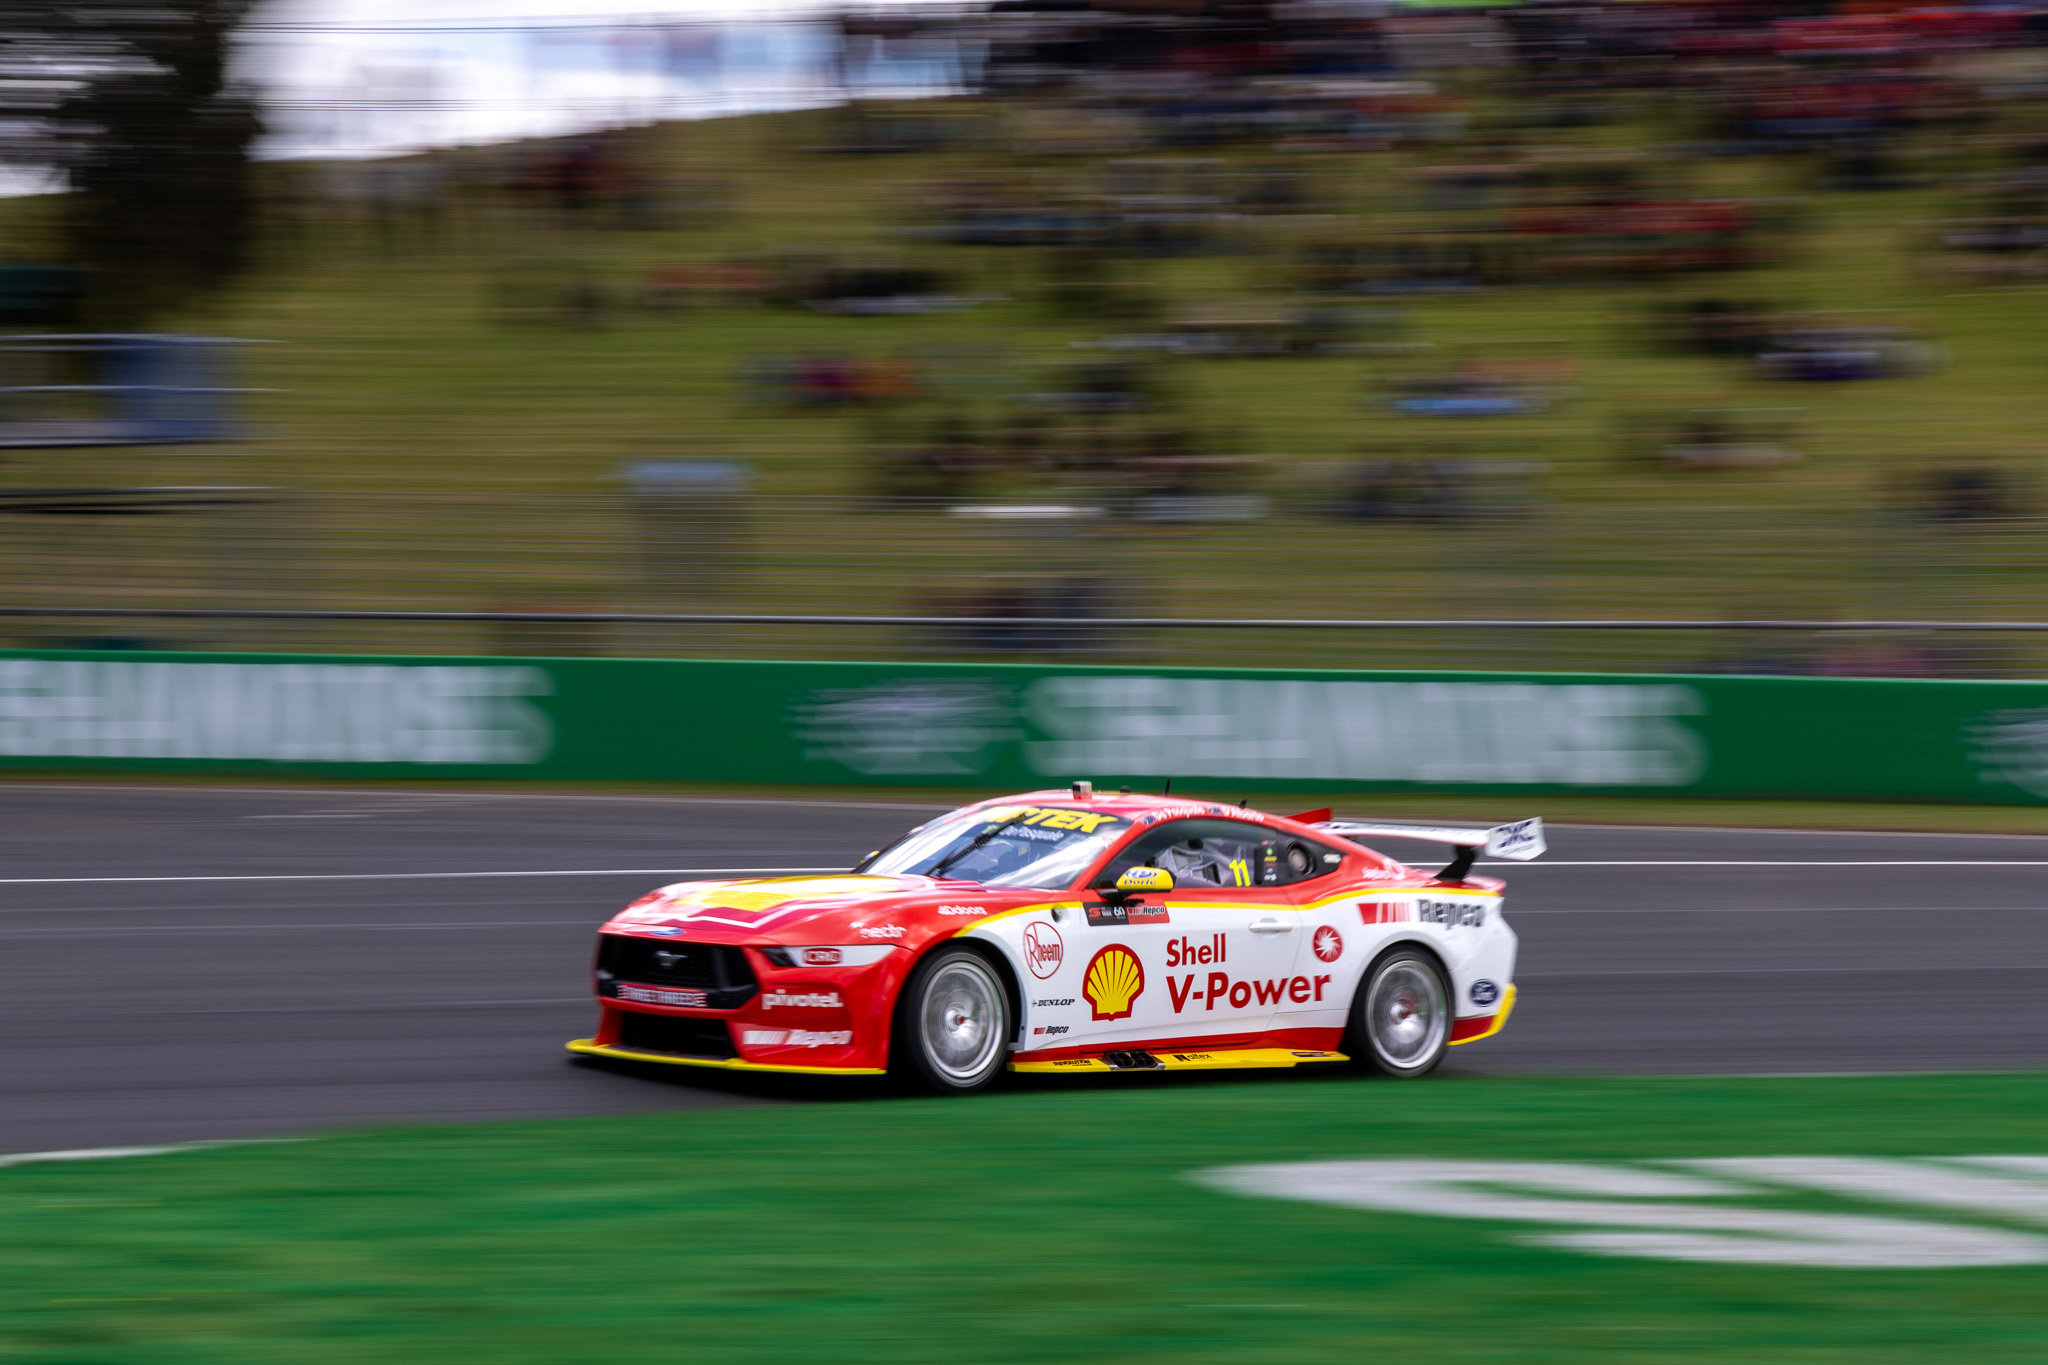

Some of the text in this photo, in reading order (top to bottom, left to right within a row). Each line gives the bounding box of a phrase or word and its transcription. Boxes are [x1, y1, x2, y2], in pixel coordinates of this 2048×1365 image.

[1229, 859, 1251, 887] 11
[1142, 905, 1165, 916] Repco
[1417, 900, 1486, 930] Repco
[1024, 923, 1060, 970] Rheem
[1166, 932, 1226, 967] Shell
[1166, 971, 1332, 1014] V-Power
[1045, 1026, 1069, 1035] Repco
